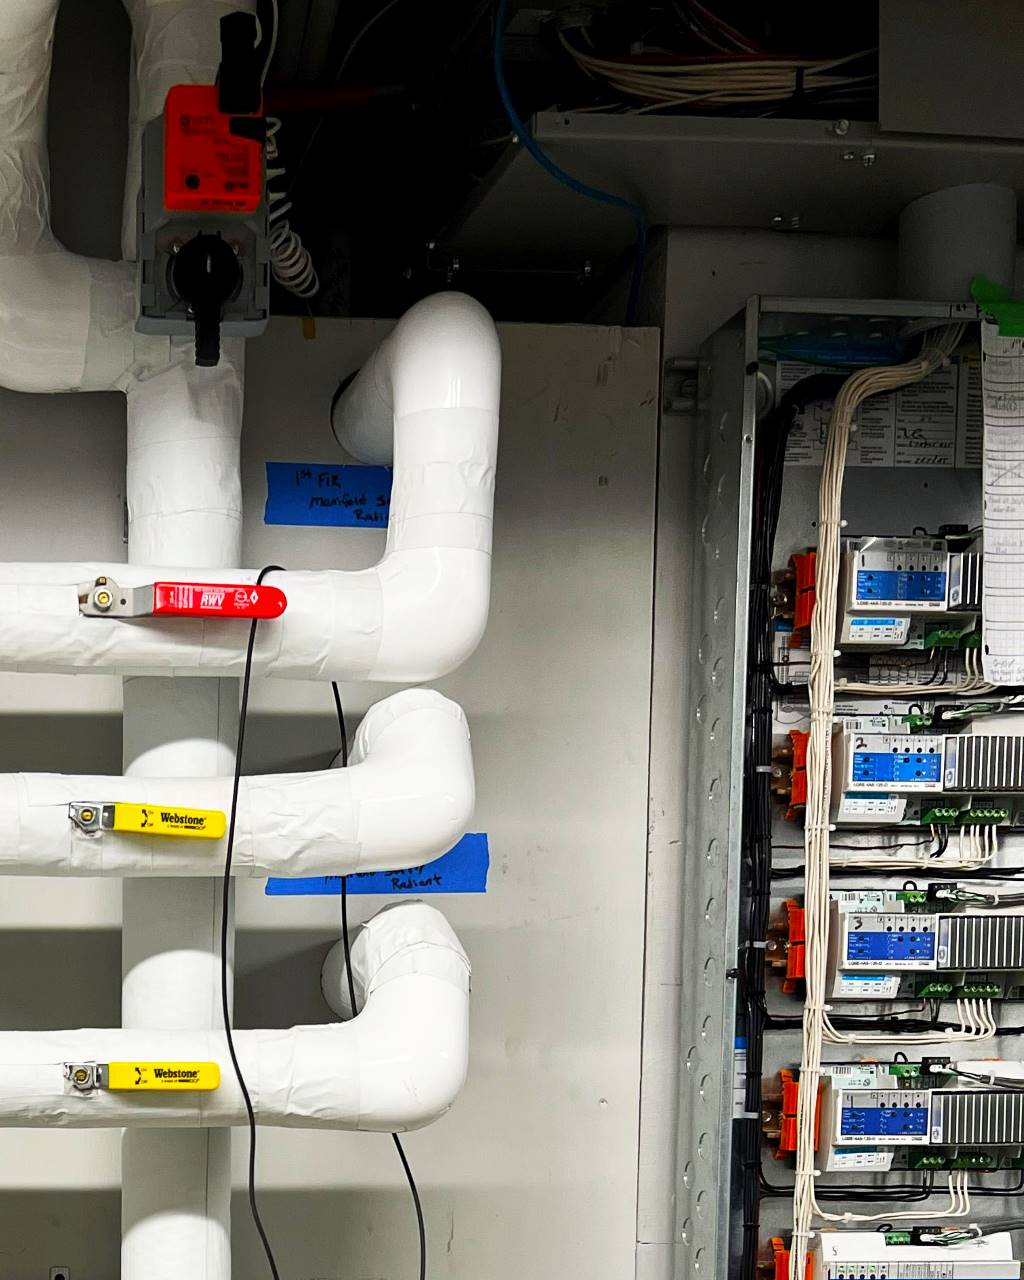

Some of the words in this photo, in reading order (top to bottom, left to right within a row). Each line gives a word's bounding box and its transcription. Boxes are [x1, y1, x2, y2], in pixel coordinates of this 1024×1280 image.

[200, 592, 225, 607] RWV
[855, 737, 867, 749] 2
[161, 812, 205, 825] Webstone
[853, 917, 863, 930] 3
[154, 1069, 198, 1078] Webstone
